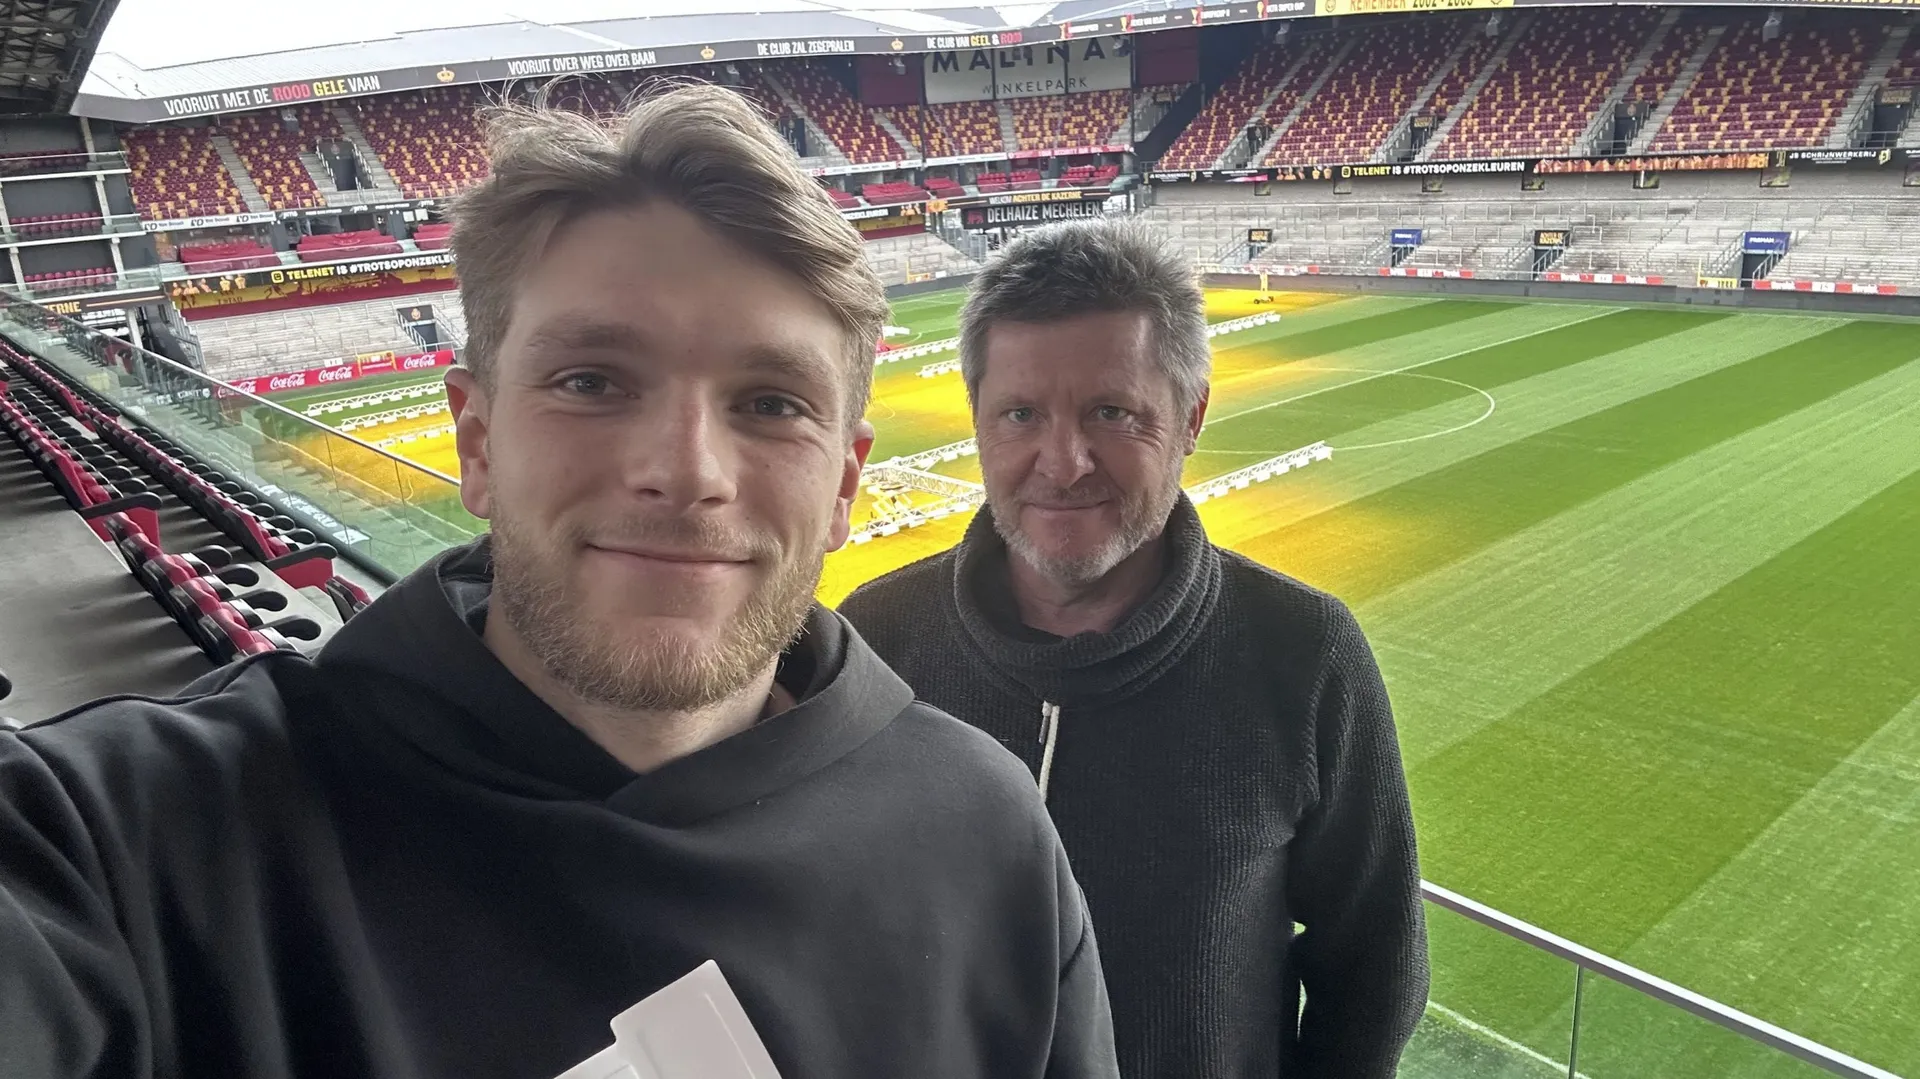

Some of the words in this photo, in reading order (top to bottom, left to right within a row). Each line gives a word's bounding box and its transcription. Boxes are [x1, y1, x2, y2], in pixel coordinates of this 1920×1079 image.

[757, 43, 768, 55] DE
[770, 42, 791, 55] CLUB
[792, 41, 808, 54] ZAL
[808, 39, 855, 53] ZEGEPRALEN
[927, 38, 936, 49] DE
[937, 37, 954, 48] CLUB
[956, 36, 970, 47] VAN
[970, 35, 991, 46] GEEL
[992, 34, 1000, 45] &
[932, 36, 1130, 73] MALINA
[507, 58, 552, 76] VOORUIT
[553, 56, 580, 72] OVER
[580, 55, 604, 70] WEG
[605, 53, 631, 68] OVER
[631, 51, 657, 66] BAAN
[982, 76, 1088, 95] WINKELPARK
[164, 94, 220, 116] VOORUIT
[222, 90, 251, 109] MET
[253, 88, 272, 105] DE
[272, 84, 311, 102] ROOD
[313, 79, 348, 97] GELE
[348, 75, 381, 92] VAAN
[1353, 166, 1392, 176] TELENET
[1392, 166, 1401, 175] IS
[1403, 162, 1525, 175] #TROTSOPONZEKLEUREN
[1012, 193, 1040, 203] ACHTER
[1042, 192, 1050, 200] DE
[987, 203, 1039, 224] DELHAIZE
[1042, 201, 1101, 220] MECHELEN
[286, 266, 335, 280] TELENET
[336, 264, 348, 276] IS
[47, 301, 82, 314] ERNE
[404, 354, 436, 370] Coca-Cola
[270, 374, 306, 391] Coca-Cola
[318, 366, 353, 383] Coca-Cola
